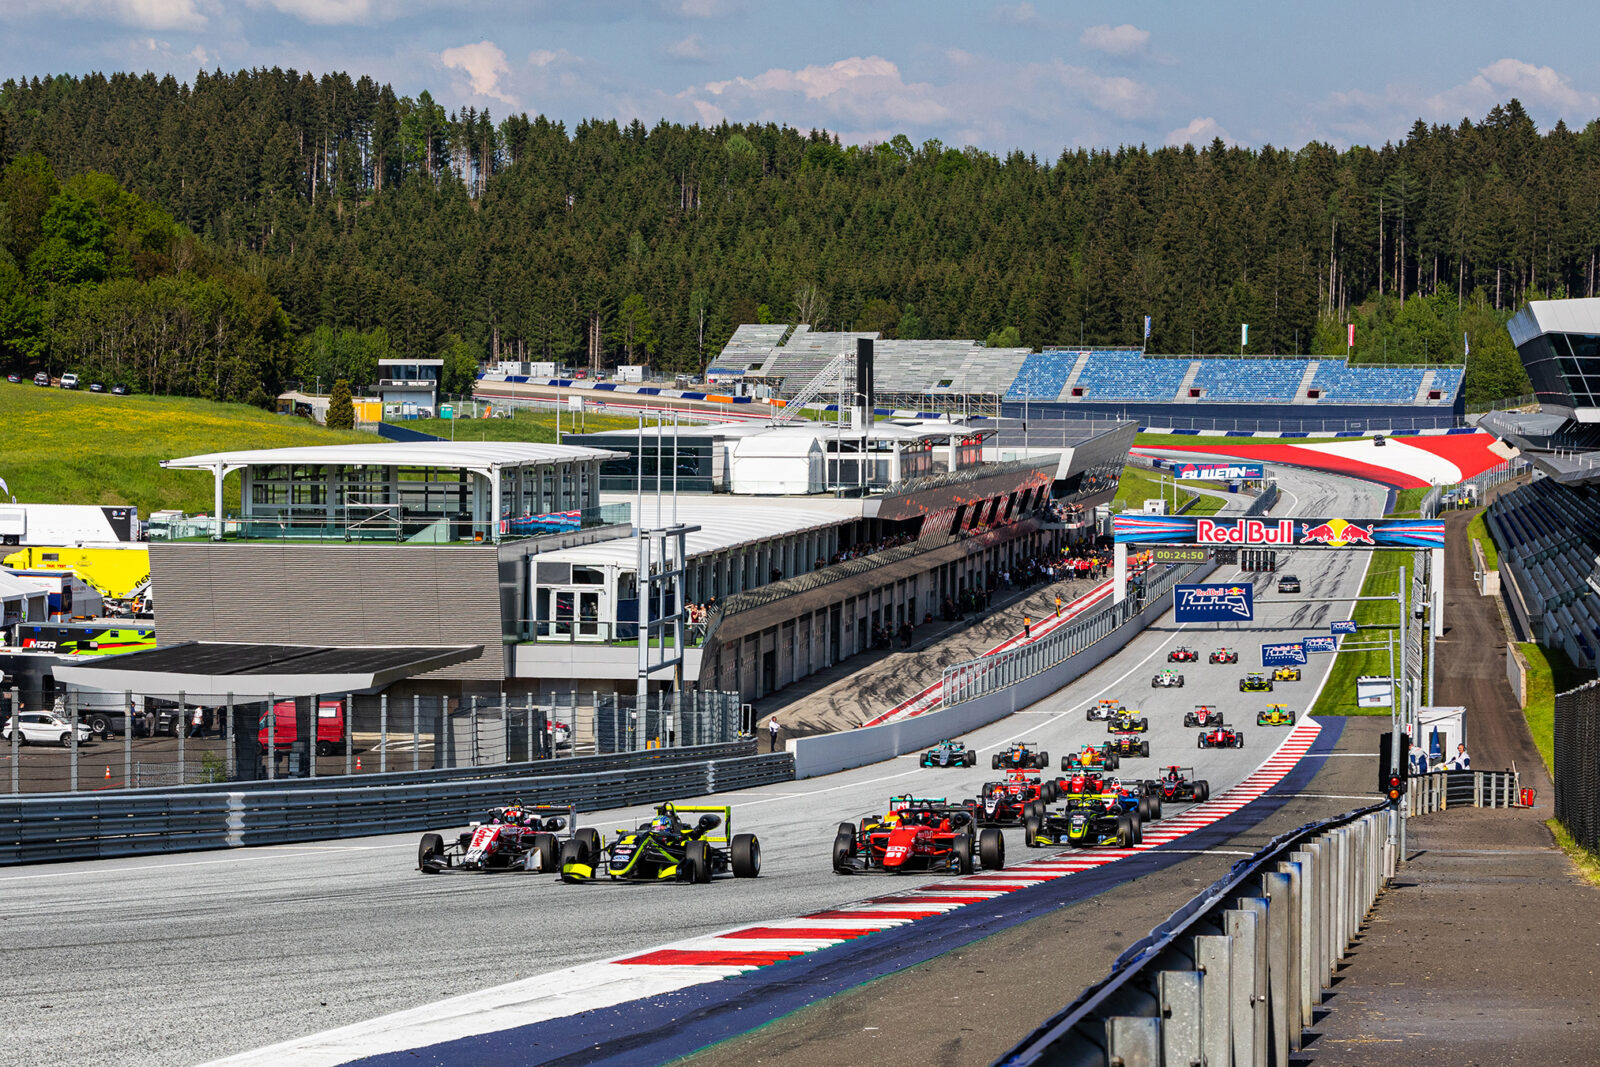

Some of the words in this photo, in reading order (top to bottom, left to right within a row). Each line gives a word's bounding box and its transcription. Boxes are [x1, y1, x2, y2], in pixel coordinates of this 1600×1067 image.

[1181, 466, 1247, 479] BULLETIN
[1197, 519, 1246, 543] Red
[1247, 520, 1294, 544] Bull
[1157, 551, 1204, 560] 00:24:50
[1196, 588, 1210, 596] Red
[1210, 587, 1224, 596] Bull
[29, 640, 57, 649] MZR
